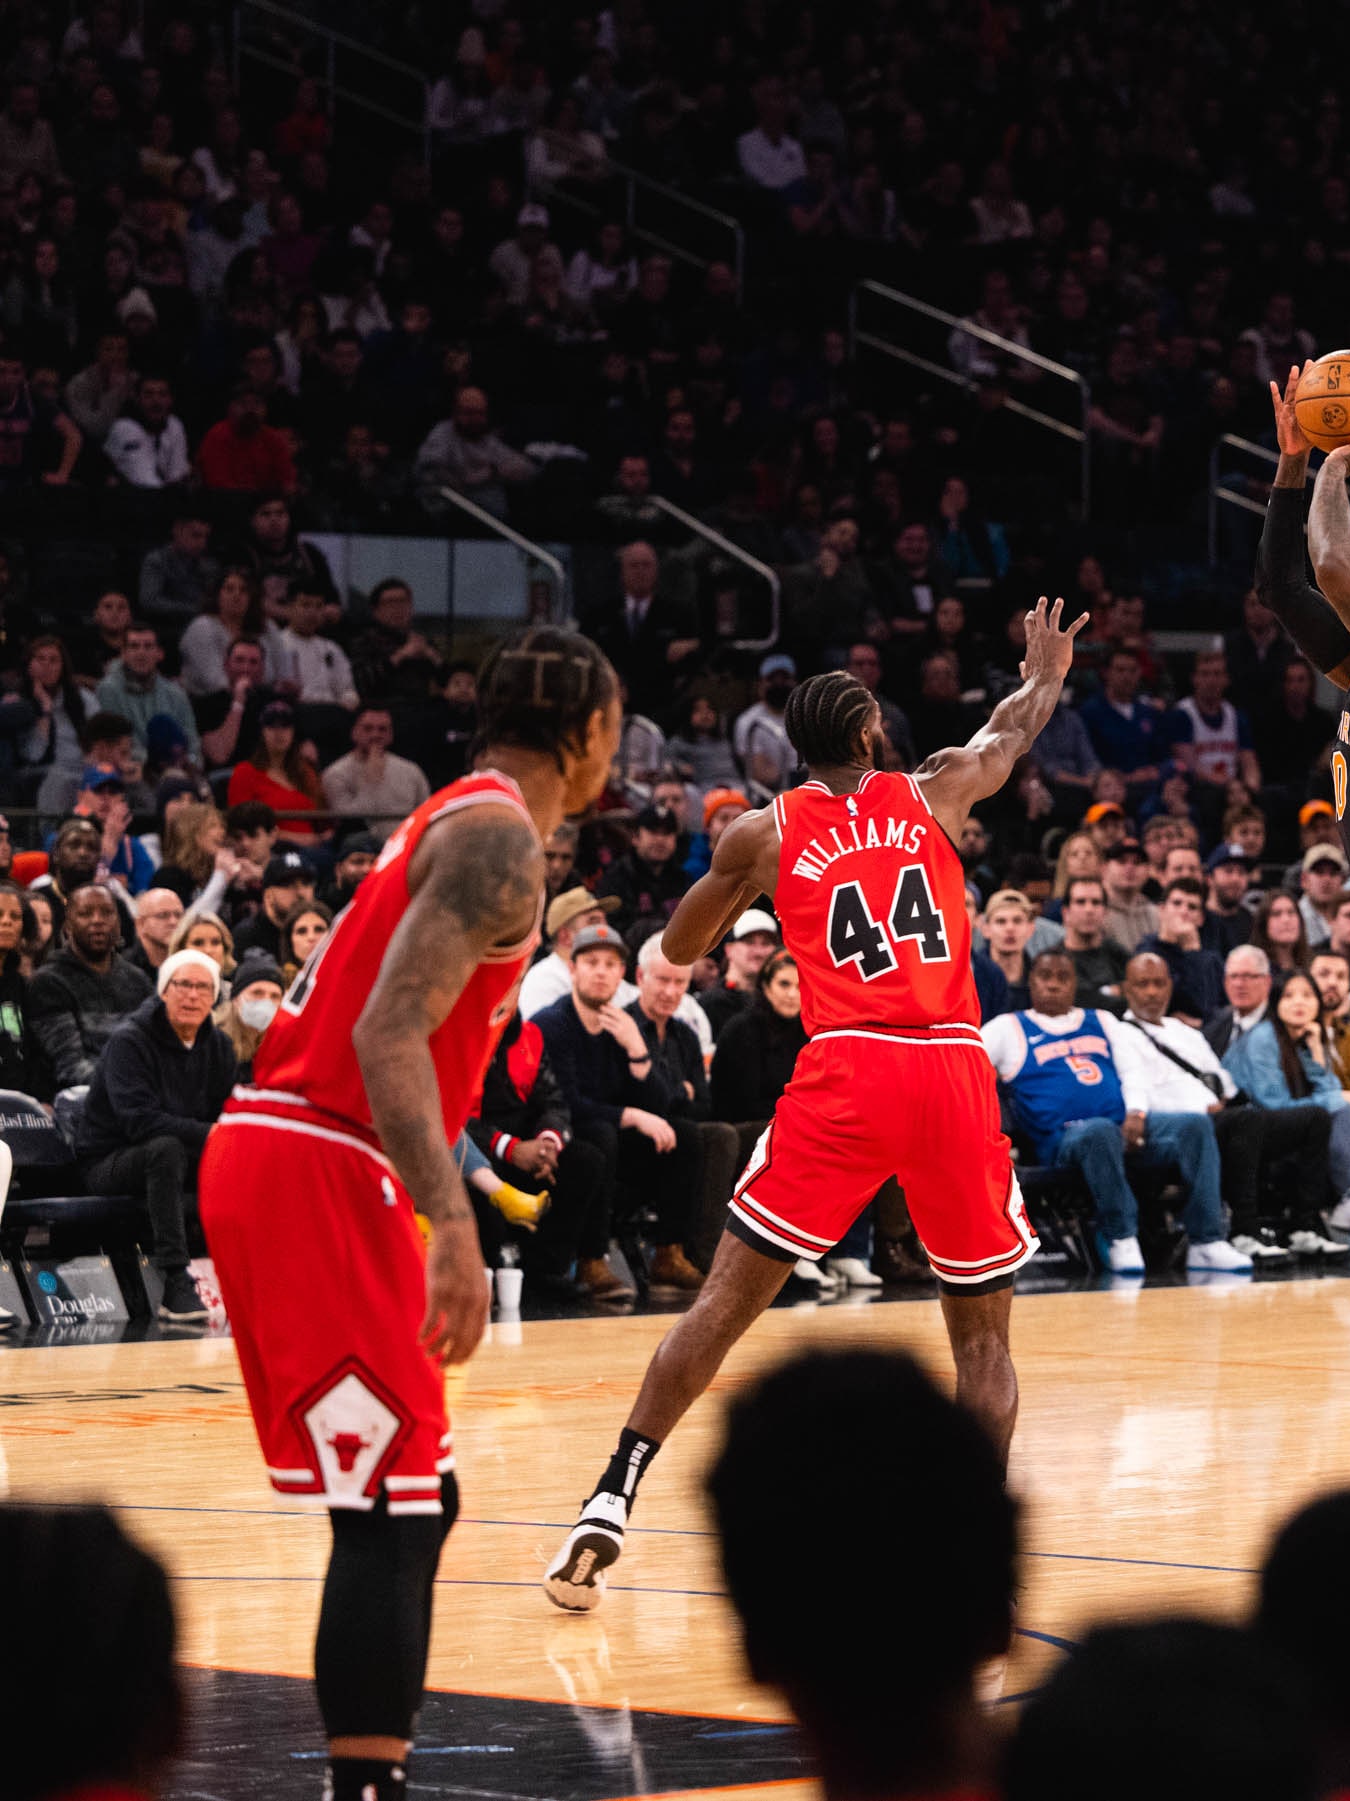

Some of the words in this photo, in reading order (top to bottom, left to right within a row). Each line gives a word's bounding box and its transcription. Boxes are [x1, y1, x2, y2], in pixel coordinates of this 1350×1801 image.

[1330, 751, 1348, 823] 0
[791, 817, 927, 882] WILLIAMS
[826, 863, 952, 983] 44
[1064, 1055, 1103, 1086] 5
[47, 1293, 116, 1320] Douglas
